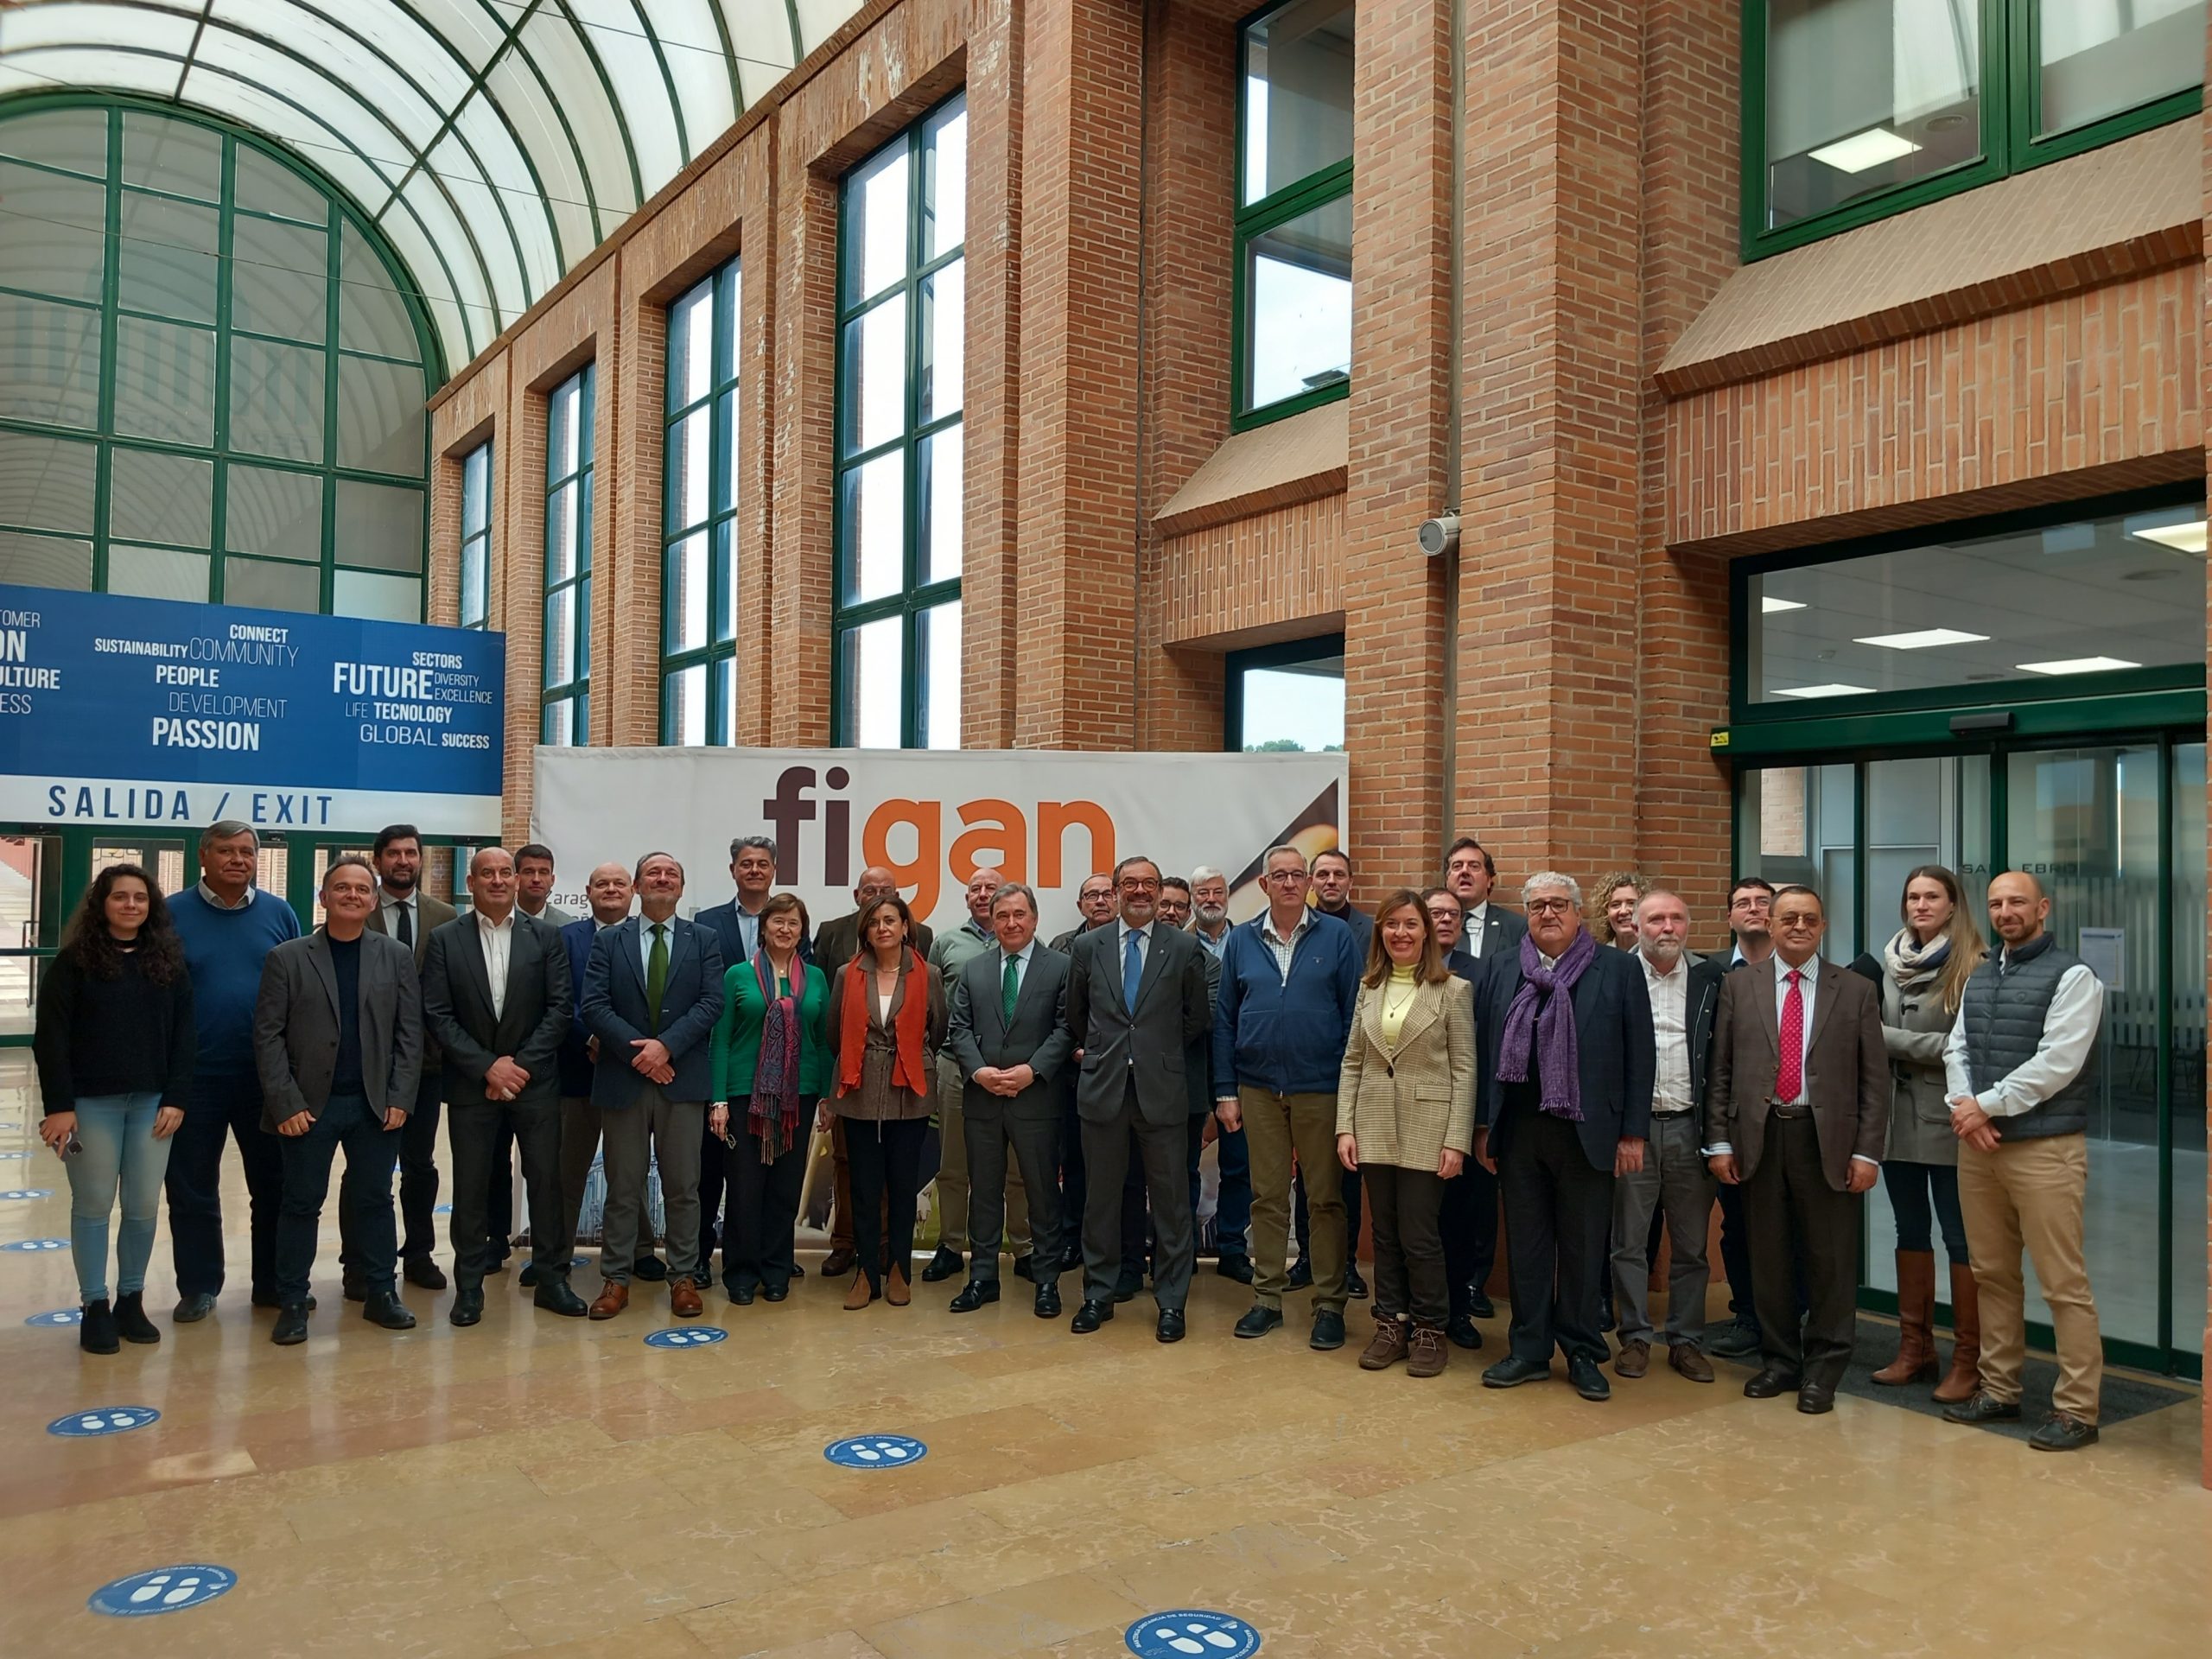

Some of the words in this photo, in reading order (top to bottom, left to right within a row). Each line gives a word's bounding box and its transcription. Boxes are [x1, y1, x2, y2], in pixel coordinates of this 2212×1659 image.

[0, 609, 41, 628] OMER
[229, 624, 289, 644] CONNECT
[94, 638, 188, 658] SUSTAINABILITY
[189, 637, 300, 667] COMMUNITY
[412, 652, 463, 671] SECTORS
[156, 664, 219, 688] PEOPLE
[333, 661, 435, 701] FUTURE
[434, 671, 480, 688] DIVERSITY
[168, 691, 289, 719] DEVELOPMENT
[435, 687, 493, 705] EXCELLENCE
[345, 701, 369, 719] LIFE
[373, 701, 454, 724] TECNOLOGY
[152, 716, 260, 752] PASSION
[359, 723, 438, 747] GLOBAL
[442, 732, 491, 750] SUCCESS
[48, 785, 190, 821] SALIDA
[251, 793, 333, 825] EXIT
[763, 766, 1116, 923] figan
